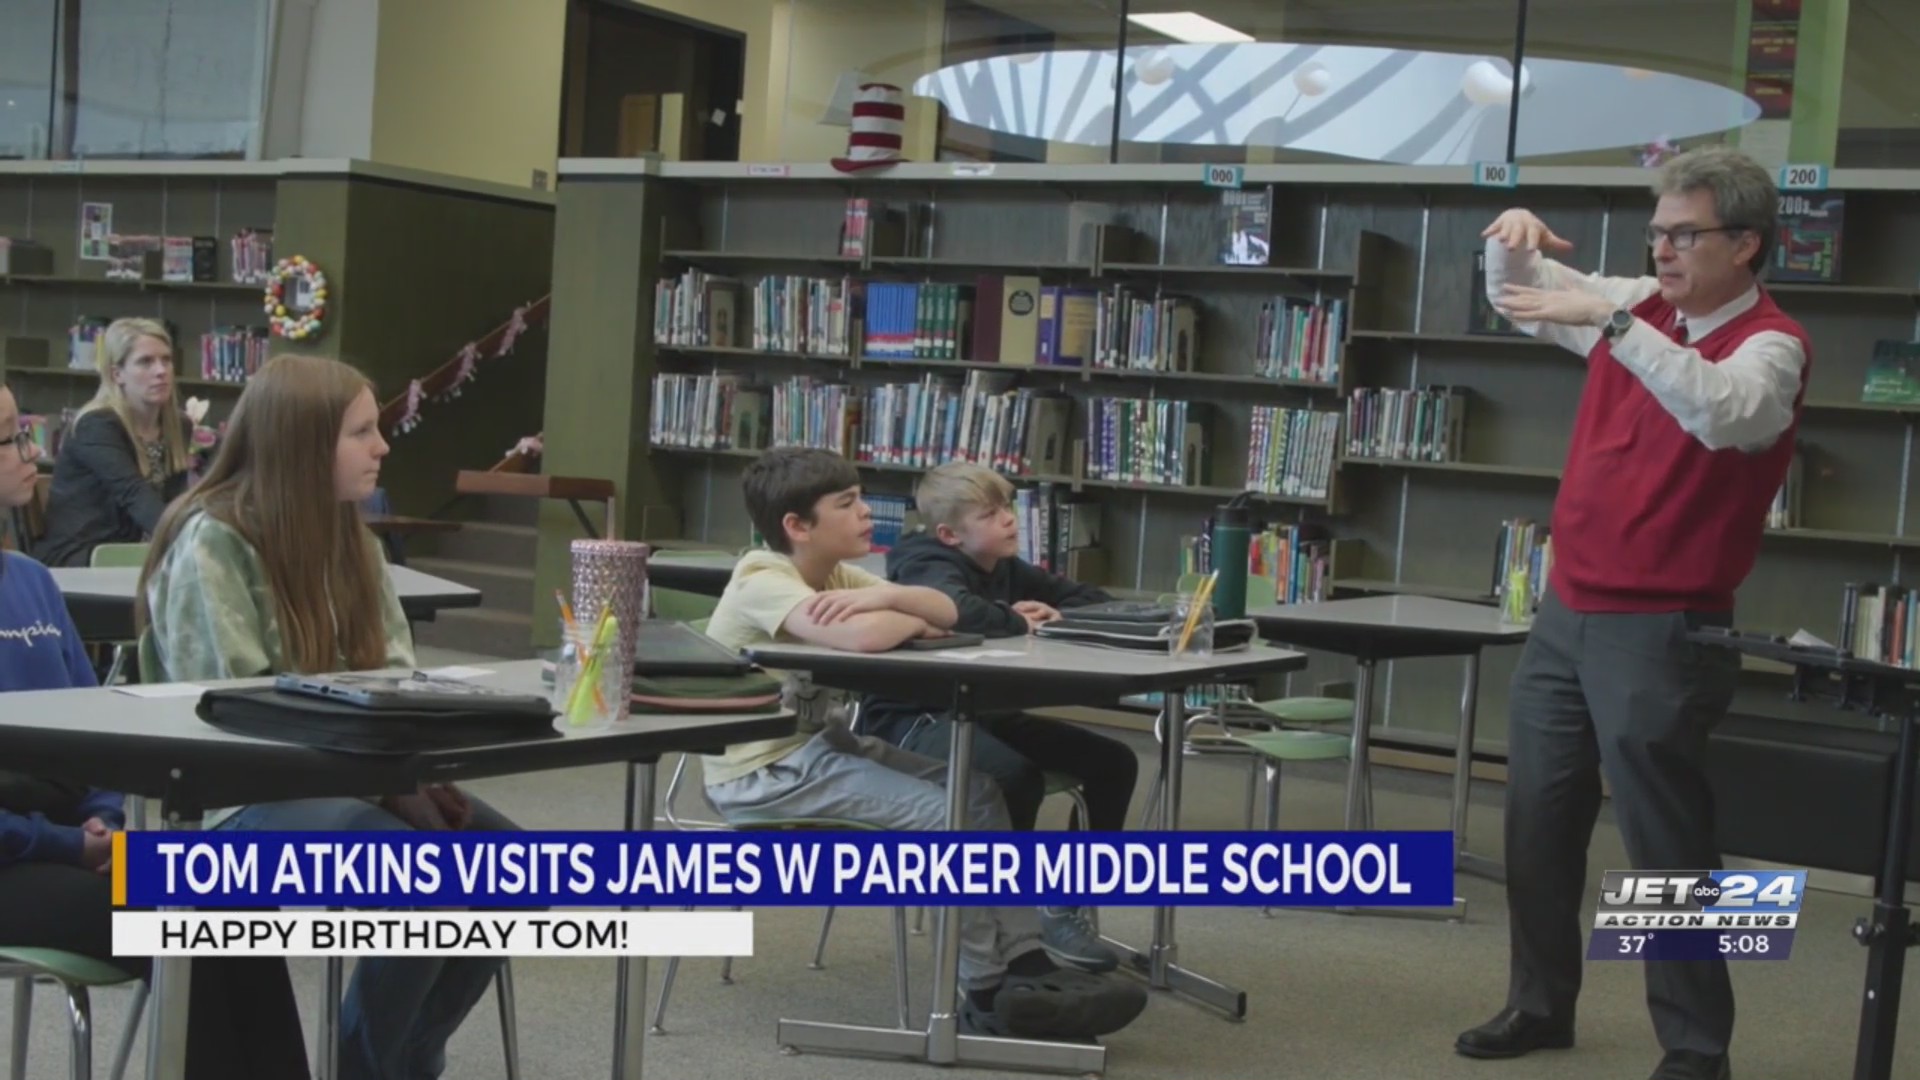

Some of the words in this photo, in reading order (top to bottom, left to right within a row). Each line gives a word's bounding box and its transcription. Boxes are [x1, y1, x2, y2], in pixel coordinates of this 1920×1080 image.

[1211, 168, 1233, 183] 000
[1485, 166, 1506, 182] 100
[1789, 168, 1817, 185] 200
